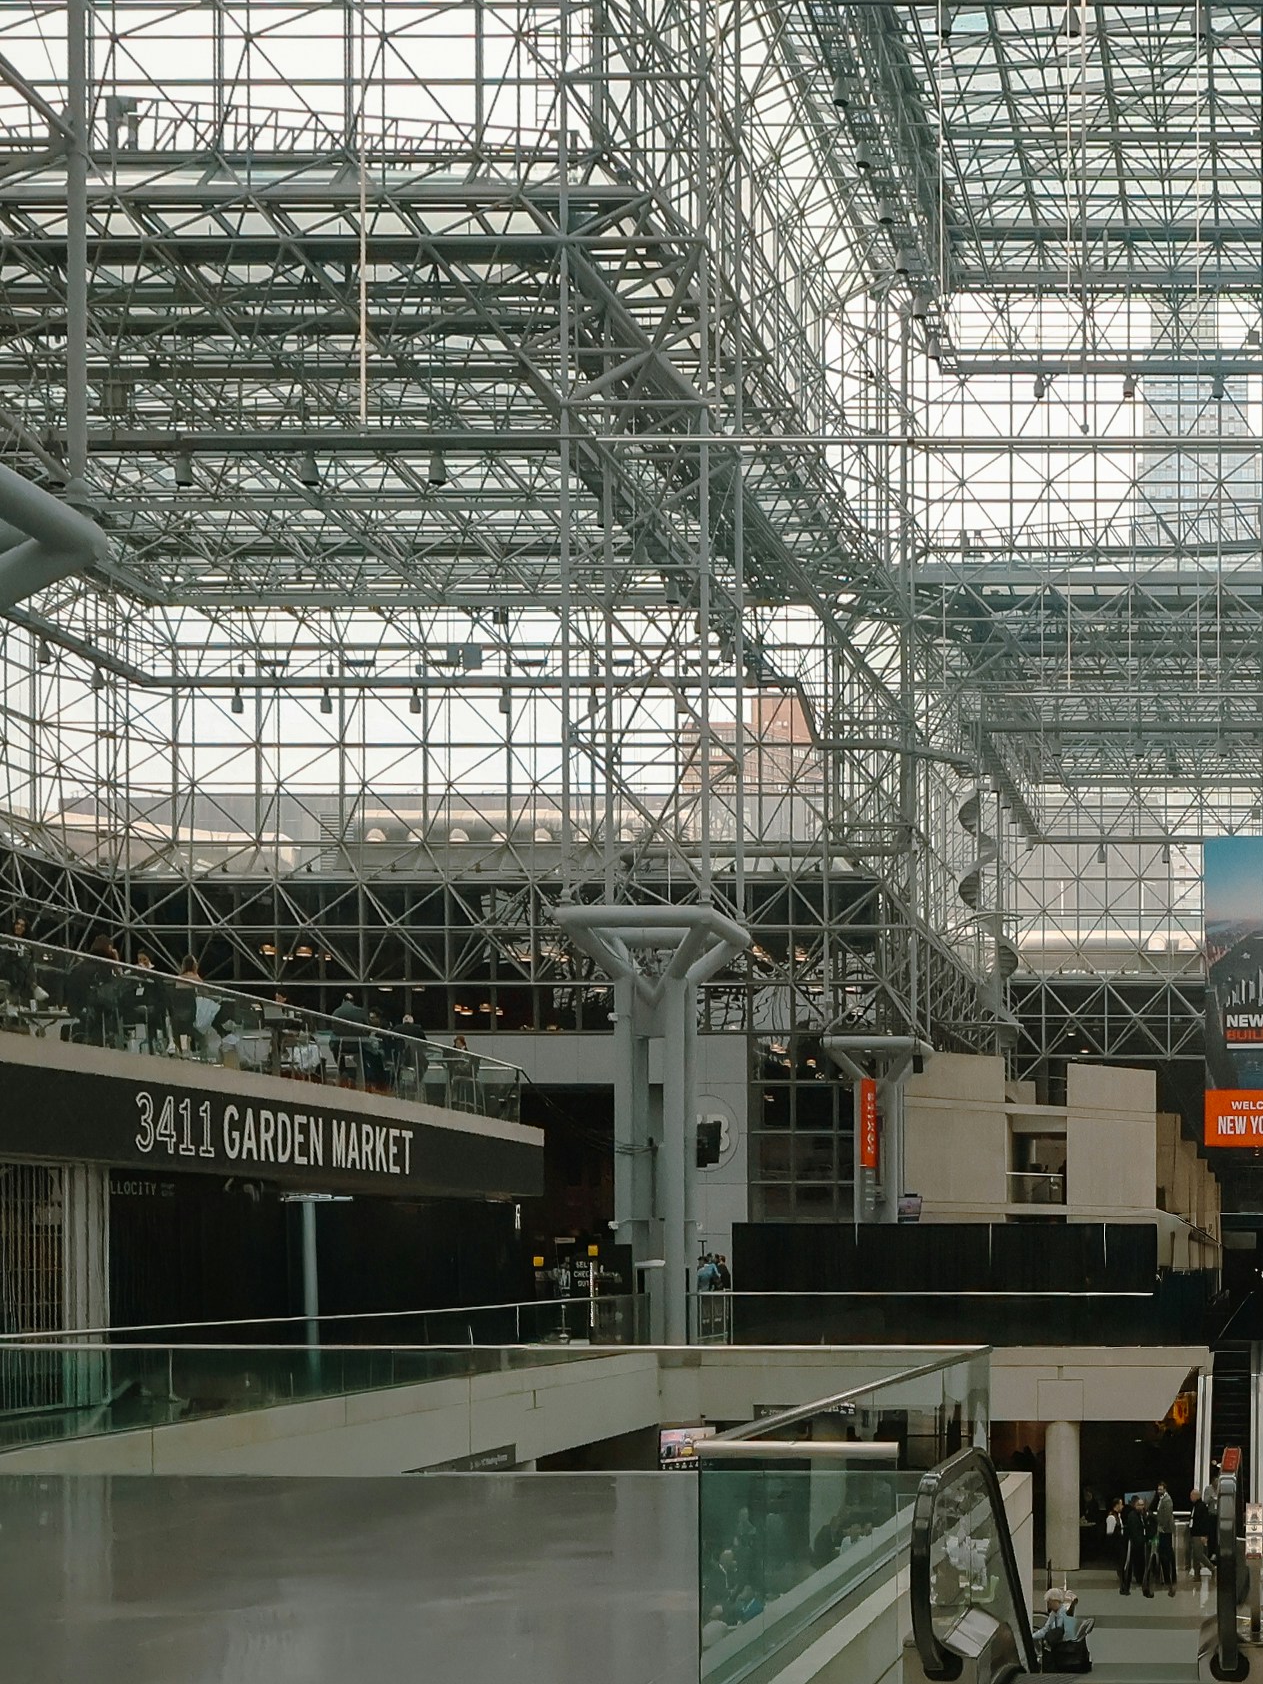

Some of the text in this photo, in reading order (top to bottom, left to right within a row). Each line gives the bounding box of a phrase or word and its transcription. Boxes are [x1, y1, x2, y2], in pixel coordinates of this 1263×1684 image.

[135, 1092, 414, 1175] 3411 GARDEN MARKET
[1218, 1116, 1247, 1135] NEW
